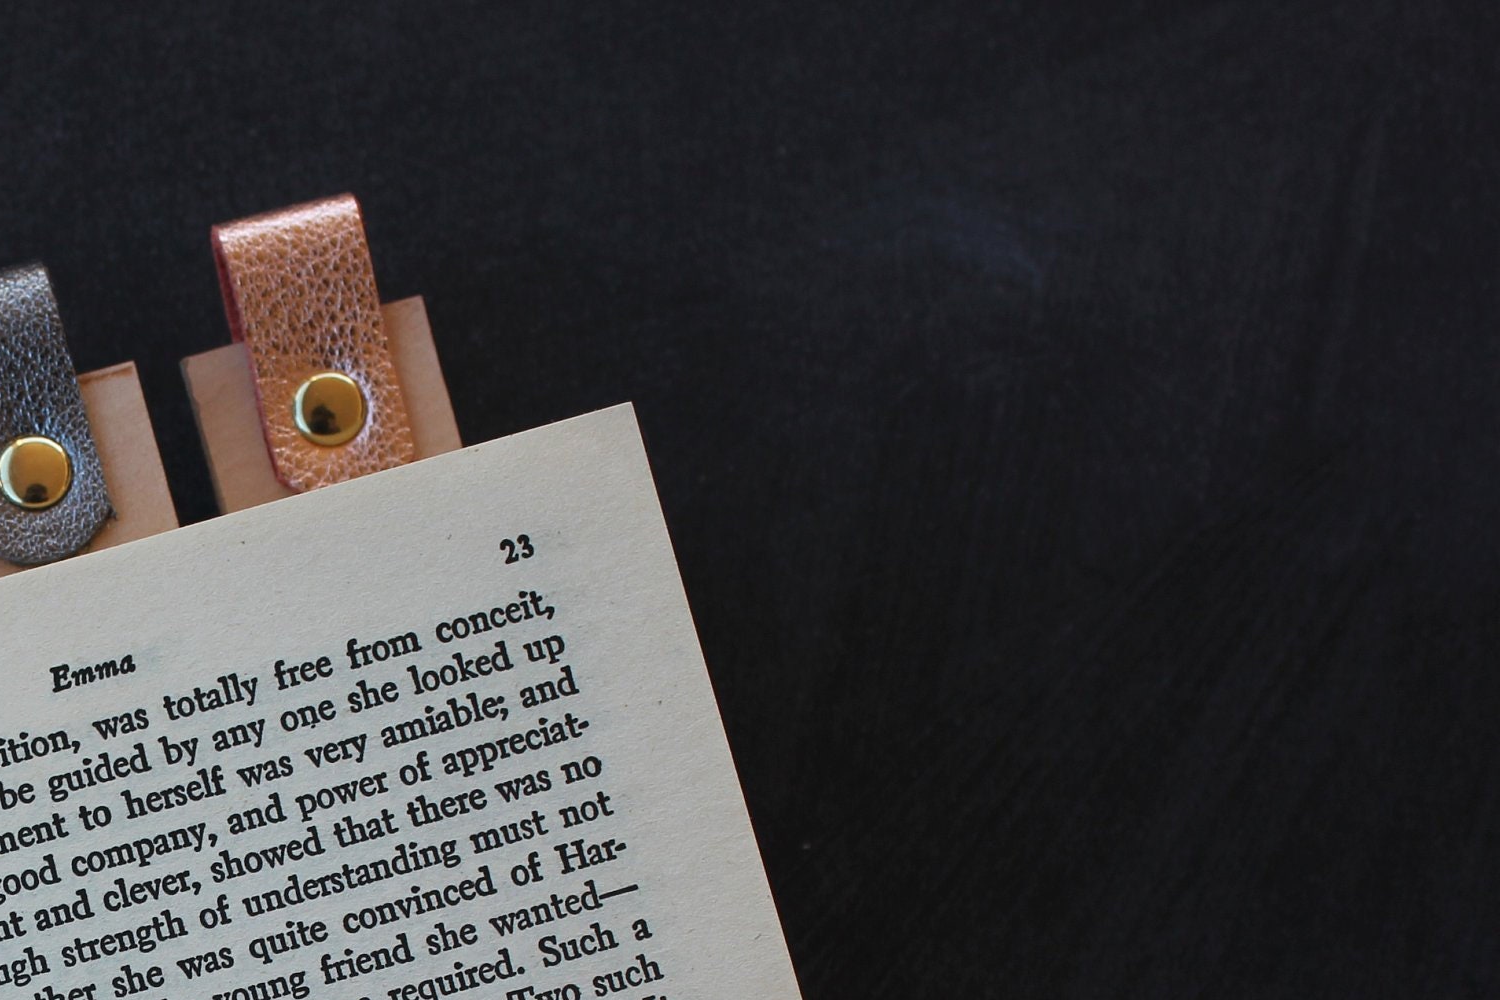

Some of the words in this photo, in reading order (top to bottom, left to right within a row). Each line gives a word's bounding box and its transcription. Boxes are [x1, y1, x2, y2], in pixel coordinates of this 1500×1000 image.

[499, 533, 535, 565] 23
[48, 654, 137, 694] Emma
[78, 805, 113, 832] to
[119, 764, 227, 820] herself
[235, 755, 294, 788] was
[303, 733, 368, 769] very
[380, 691, 510, 749] amiable;
[519, 664, 581, 709] and
[33, 887, 96, 932] and
[102, 869, 202, 912] clever,
[209, 825, 327, 884] showed
[332, 808, 400, 849] that
[406, 788, 488, 828] there
[493, 769, 553, 804] was
[559, 755, 603, 785] no
[111, 964, 165, 998] she
[175, 946, 235, 980] was
[248, 920, 329, 965] quite
[342, 864, 499, 934] convinced
[510, 850, 545, 887] of
[553, 838, 627, 875] Har-
